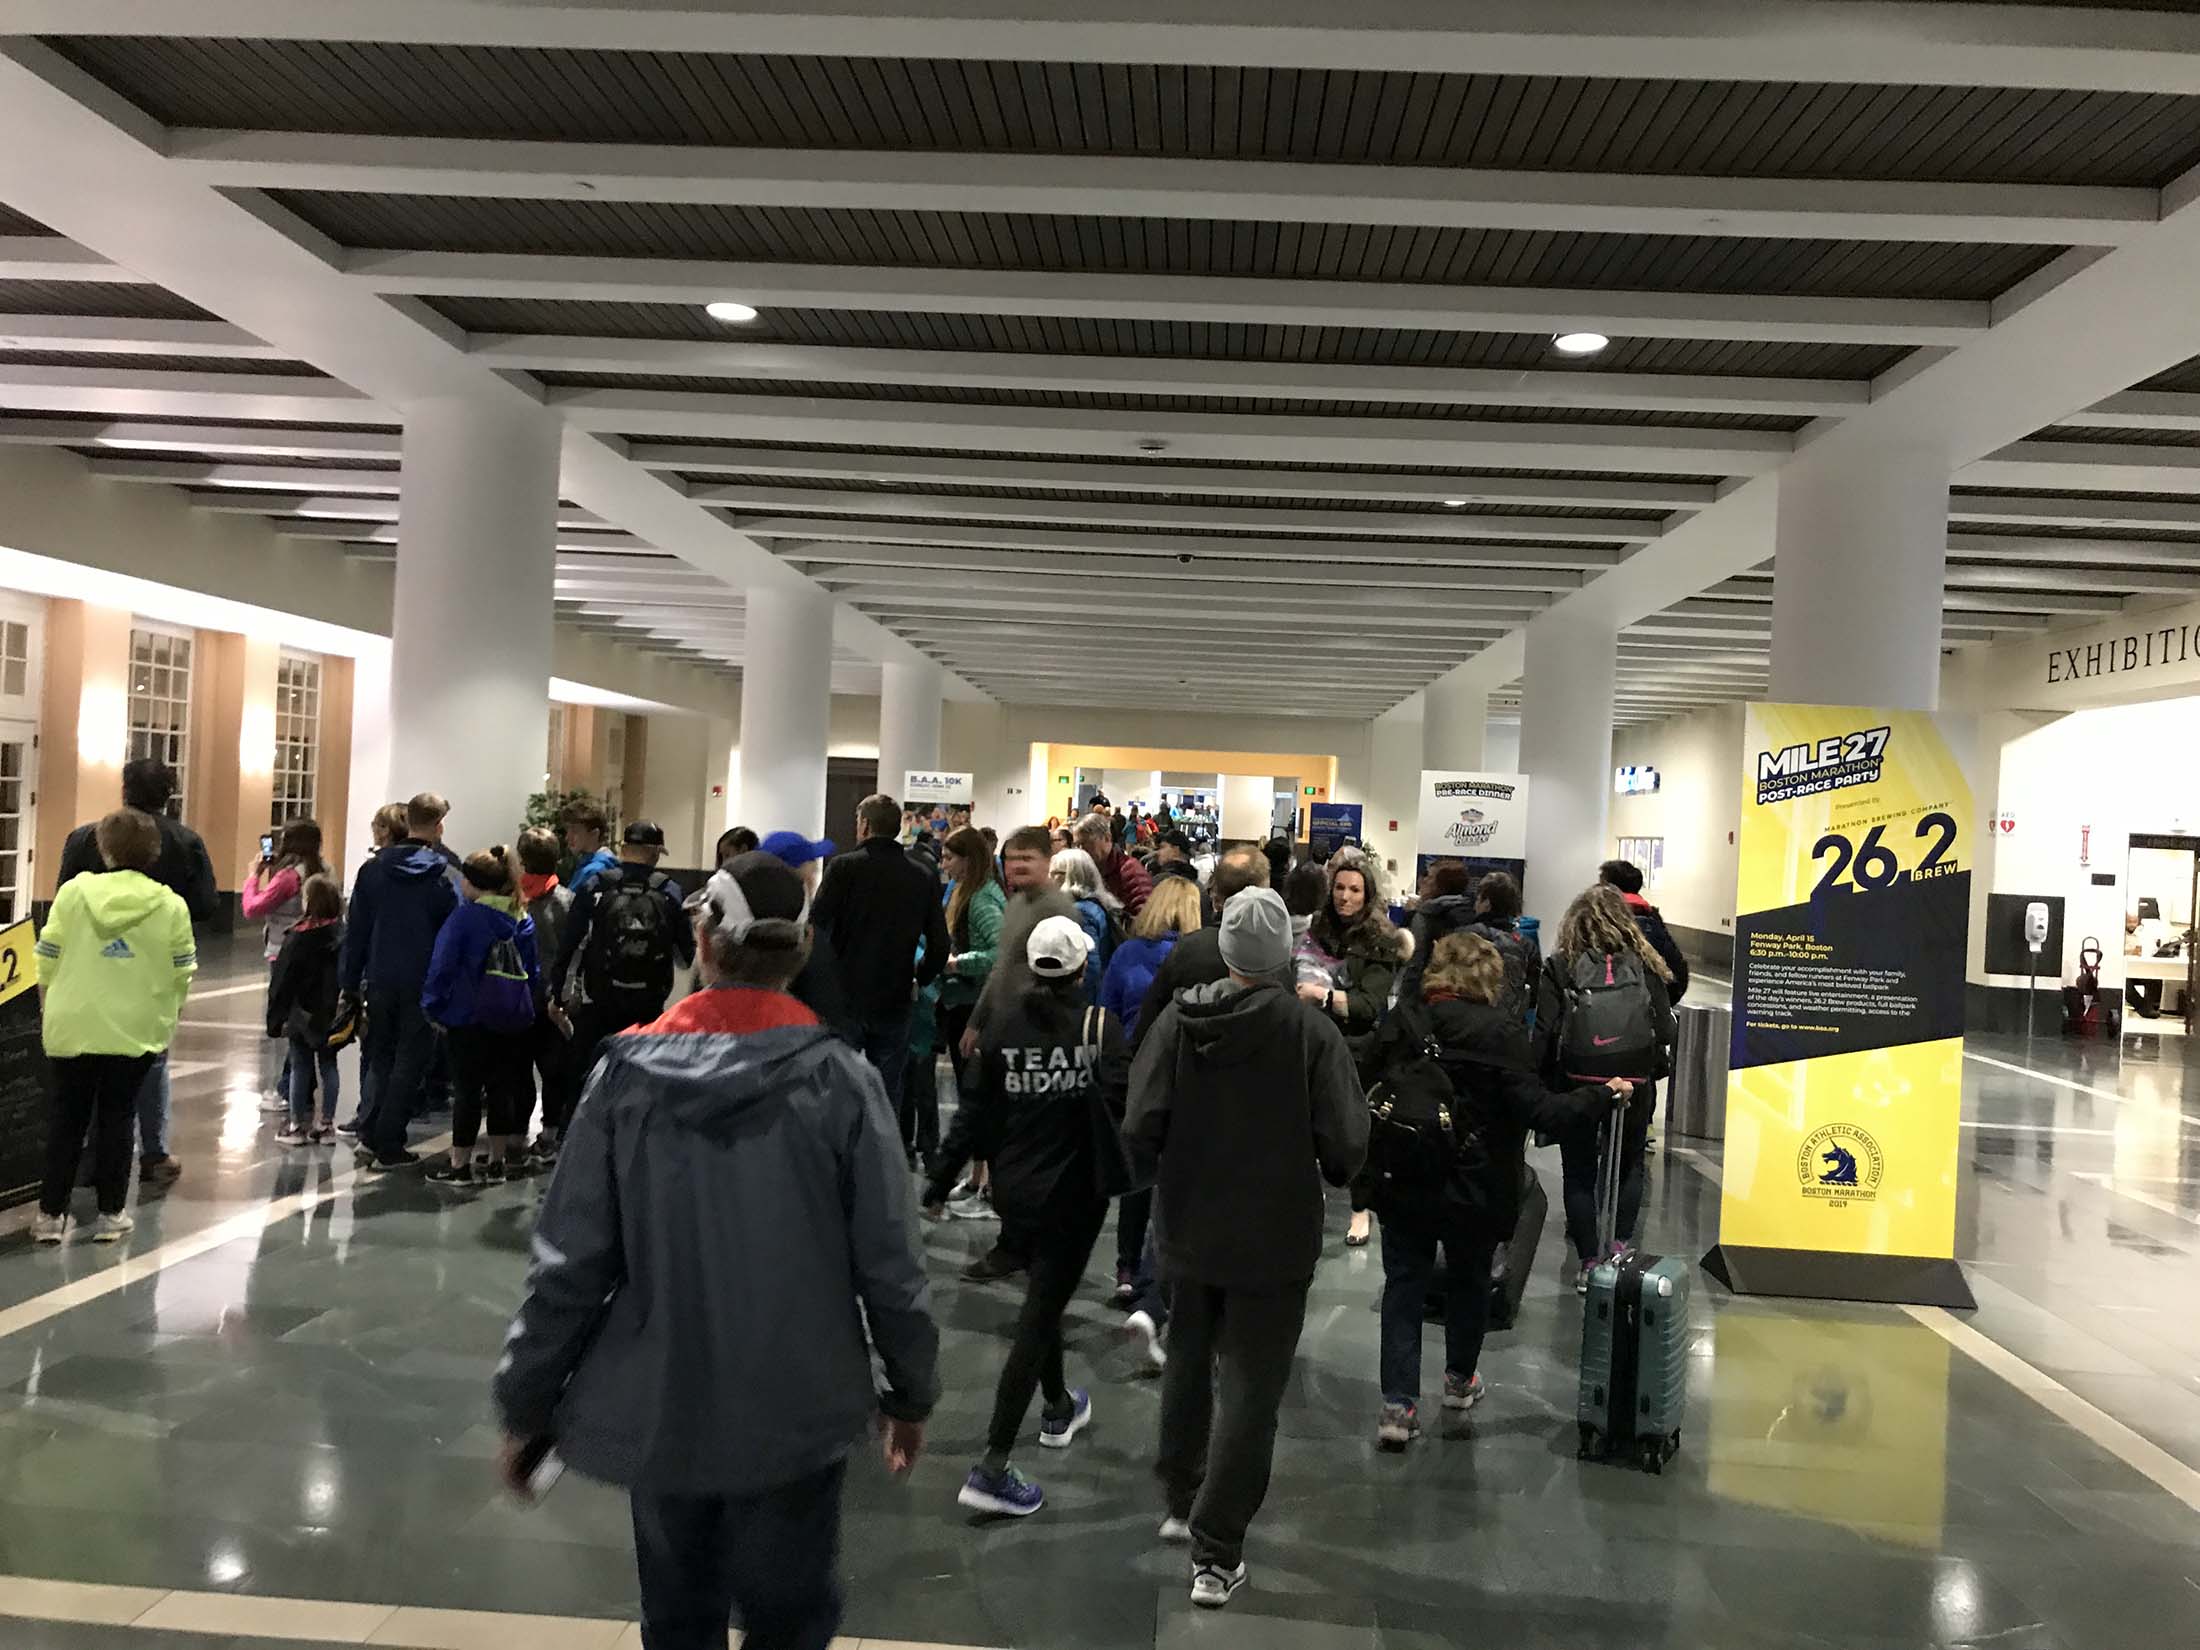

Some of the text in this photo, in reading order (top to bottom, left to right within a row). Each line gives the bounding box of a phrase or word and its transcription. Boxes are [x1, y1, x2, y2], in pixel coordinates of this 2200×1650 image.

[1760, 728, 1889, 780] MILE 27
[910, 775, 962, 785] B.A.A. 10K
[1760, 759, 1880, 791] BOSTON MARATHON
[1434, 782, 1514, 793] BOSTON MARATHON
[1758, 769, 1879, 803] POST-RACE PARTY
[1436, 789, 1477, 798] PRE-RACE
[1824, 802, 1950, 832] MARATHON BREWING COMPANY
[1444, 820, 1499, 838] Almond
[1914, 863, 1958, 881] BREW
[1750, 932, 1815, 943] Monday, April 15
[1750, 940, 1833, 951] Fenway Park, Boston
[1749, 948, 1766, 956] 6:30
[1811, 952, 1828, 960] p.m.
[1797, 966, 1852, 974] accomplishment
[1843, 975, 1868, 983] Fenway
[1876, 994, 1918, 1002] presentation
[1001, 1044, 1098, 1070] TEAM
[1800, 1126, 1881, 1183] BOSTON ATHLETIC ASSOCIATION
[1802, 1187, 1876, 1198] BOSTON MARATHON
[1829, 1200, 1848, 1208] 2019
